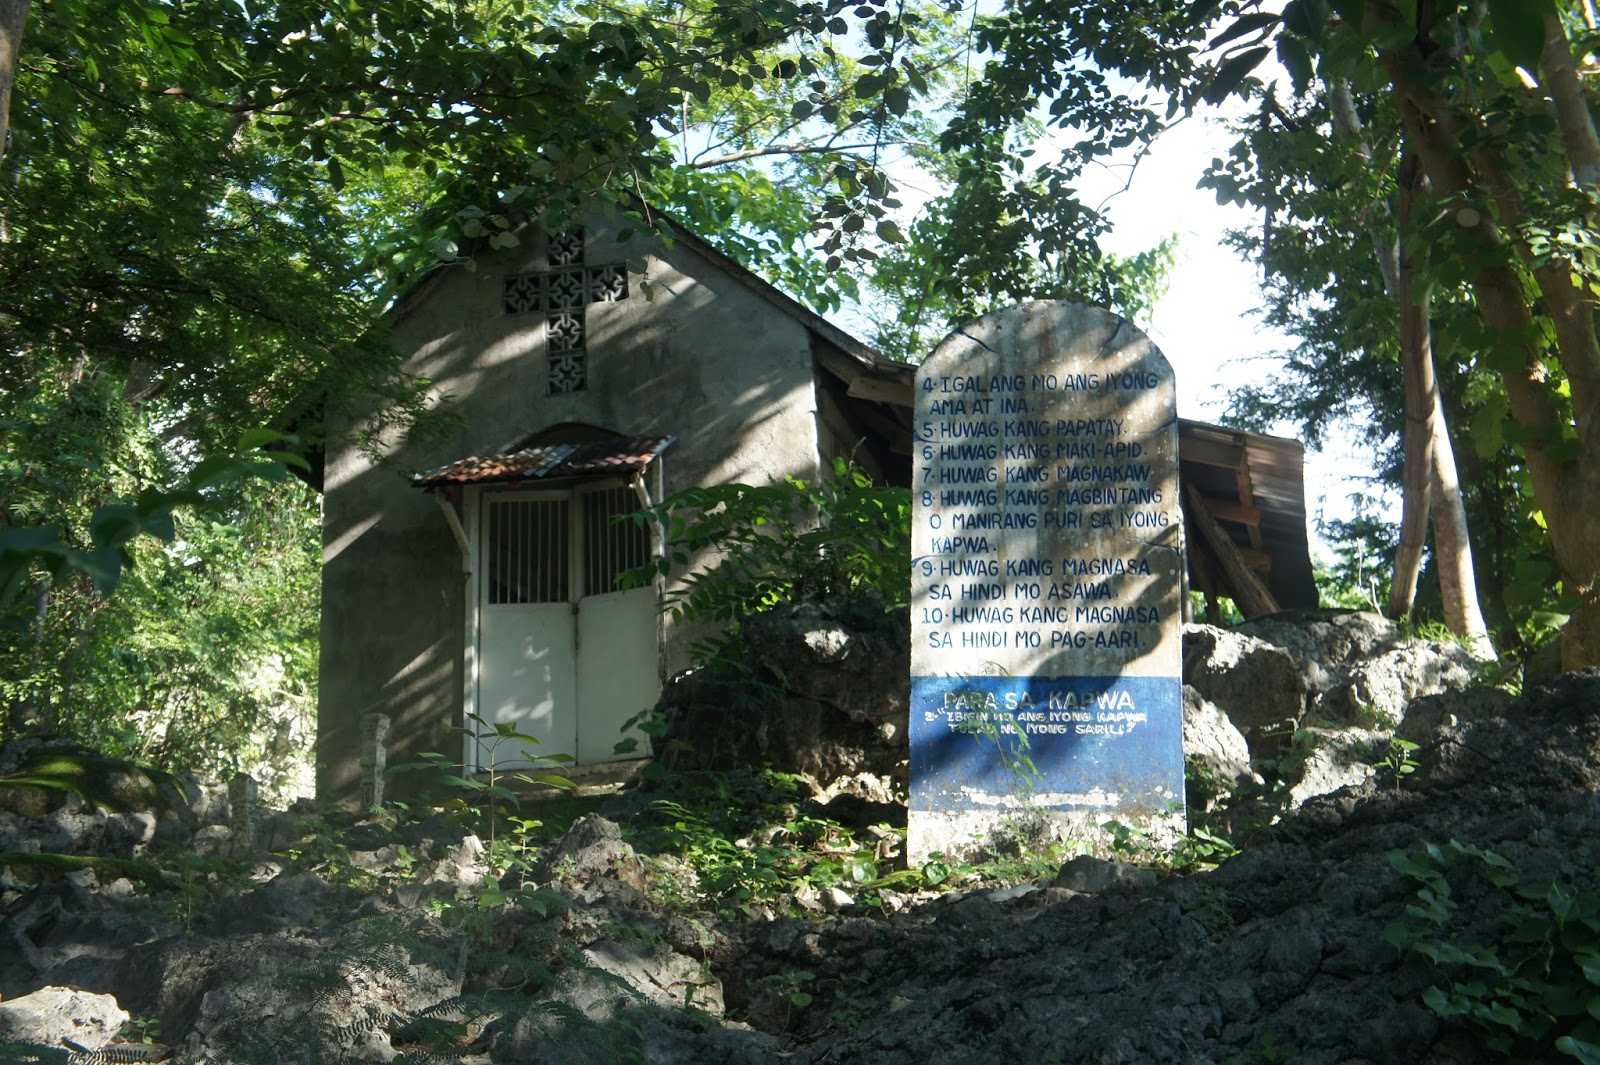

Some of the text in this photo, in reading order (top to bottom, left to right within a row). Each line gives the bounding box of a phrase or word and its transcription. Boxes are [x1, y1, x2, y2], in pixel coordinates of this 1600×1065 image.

[941, 375, 1026, 393] IGALANG
[1031, 375, 1057, 392] MO
[1064, 374, 1100, 391] ANG
[1105, 373, 1158, 390] IYONG
[930, 399, 1035, 415] AMA AT INA.
[941, 421, 999, 438] HUWAG
[1004, 421, 1050, 438] KANG
[1056, 419, 1127, 437] PAPATAY.
[940, 444, 997, 461] HUWAG
[1004, 443, 1050, 460] KANG
[940, 467, 997, 483] HUWAG
[1005, 466, 1049, 483] KANG
[940, 490, 997, 506] HUWAG
[1005, 489, 1049, 506] KANG
[1056, 488, 1163, 505] MAGBINTANG
[952, 513, 1037, 529] MANIRANG
[1043, 513, 1083, 529] PURI
[1090, 512, 1112, 529] SA
[1119, 511, 1169, 528] IYONG
[931, 537, 997, 553] KAPWA.
[941, 560, 999, 576] HUWAG
[1006, 559, 1053, 576] KANG
[1062, 558, 1151, 576] MAGNASA
[929, 582, 1119, 600] SA HINDI MO ASAWA.
[952, 607, 1013, 624] HUWAG
[1020, 606, 1068, 623] KANG
[1075, 606, 1160, 623] MAGNASA
[929, 631, 1146, 649] SA HINDI MO PAG-AARI.
[944, 690, 1135, 710] PARA SA KAPWA
[1017, 711, 1046, 722] ANG
[1050, 711, 1092, 722] IYONG
[1096, 711, 1147, 722] KAPWA
[1026, 722, 1068, 735] IYONG
